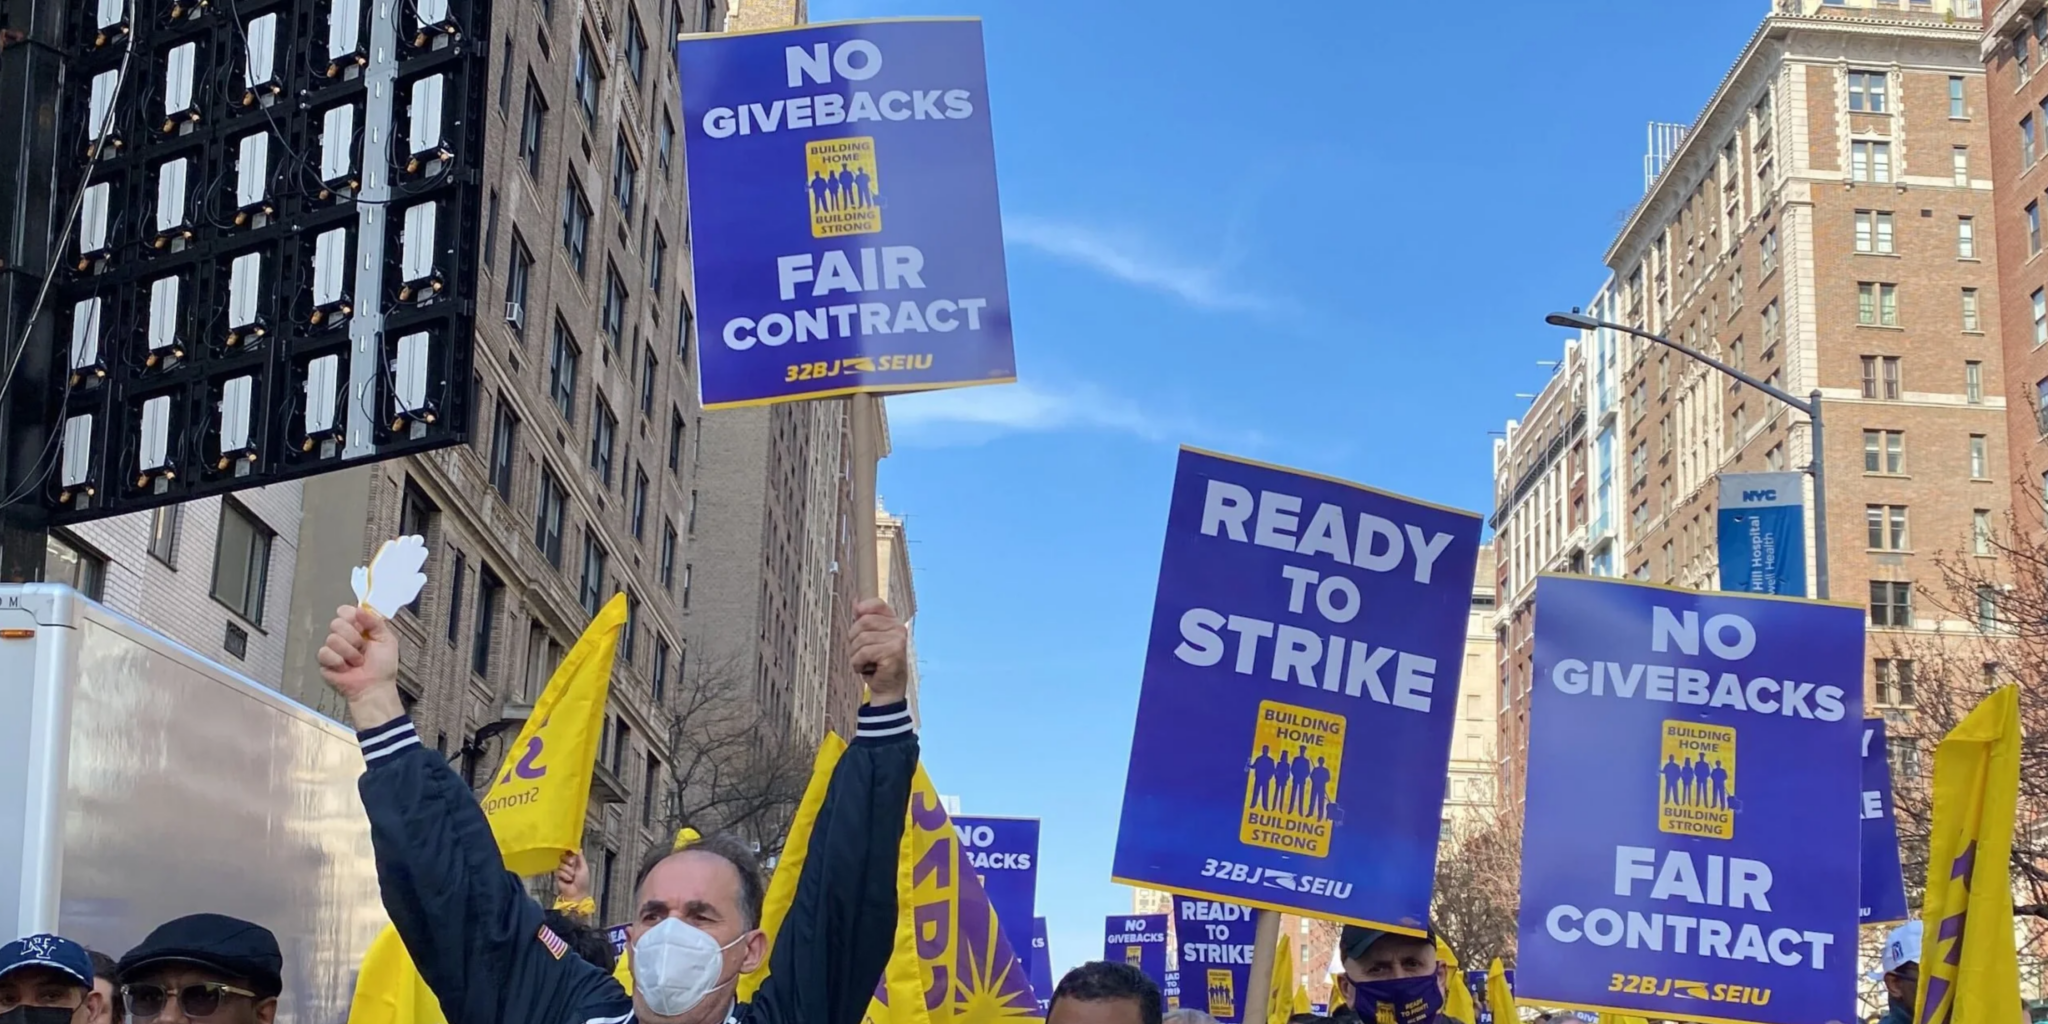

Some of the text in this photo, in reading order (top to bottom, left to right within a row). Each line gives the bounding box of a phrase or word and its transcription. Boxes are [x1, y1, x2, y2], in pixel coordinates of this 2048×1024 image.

[786, 39, 882, 88] NO
[703, 89, 973, 139] GIVEBACKS
[811, 142, 870, 155] BUILDING
[822, 152, 860, 163] HOME
[816, 211, 875, 225] BUILDING
[821, 222, 872, 234] STRONG
[777, 246, 925, 301] FAIR
[723, 298, 986, 351] CONTRACT
[785, 354, 933, 382] 32BJ SEIU
[1743, 489, 1776, 502] NYC
[1200, 479, 1454, 584] READY
[1749, 516, 1763, 592] Hill Hospital
[1763, 532, 1775, 570] Health
[1282, 565, 1361, 623] TO
[1652, 605, 1757, 661] NO
[1174, 607, 1438, 714] STRIKE
[1552, 658, 1846, 722] GIVEBACKS
[1264, 709, 1340, 734] BUILDING
[1276, 727, 1325, 747] HOME
[1667, 727, 1731, 742] BUILDING
[1679, 740, 1719, 752] HOME
[1248, 812, 1325, 837] BUILDING
[1664, 807, 1728, 823] BUILDING
[1669, 820, 1723, 835] STRONG
[953, 825, 995, 847] NO
[1252, 829, 1317, 851] STRONG
[1201, 858, 1354, 899] 32BJ SEIU
[1615, 844, 1773, 913] FAIR
[1181, 901, 1253, 921] READY
[1125, 919, 1146, 932] NO
[1205, 924, 1230, 941] TO
[1546, 904, 1834, 970] CONTRACT
[1107, 933, 1164, 944] GIVEBACKS
[1183, 942, 1255, 964] STRIKE
[1608, 973, 1771, 1005] 32BJ SEIU
